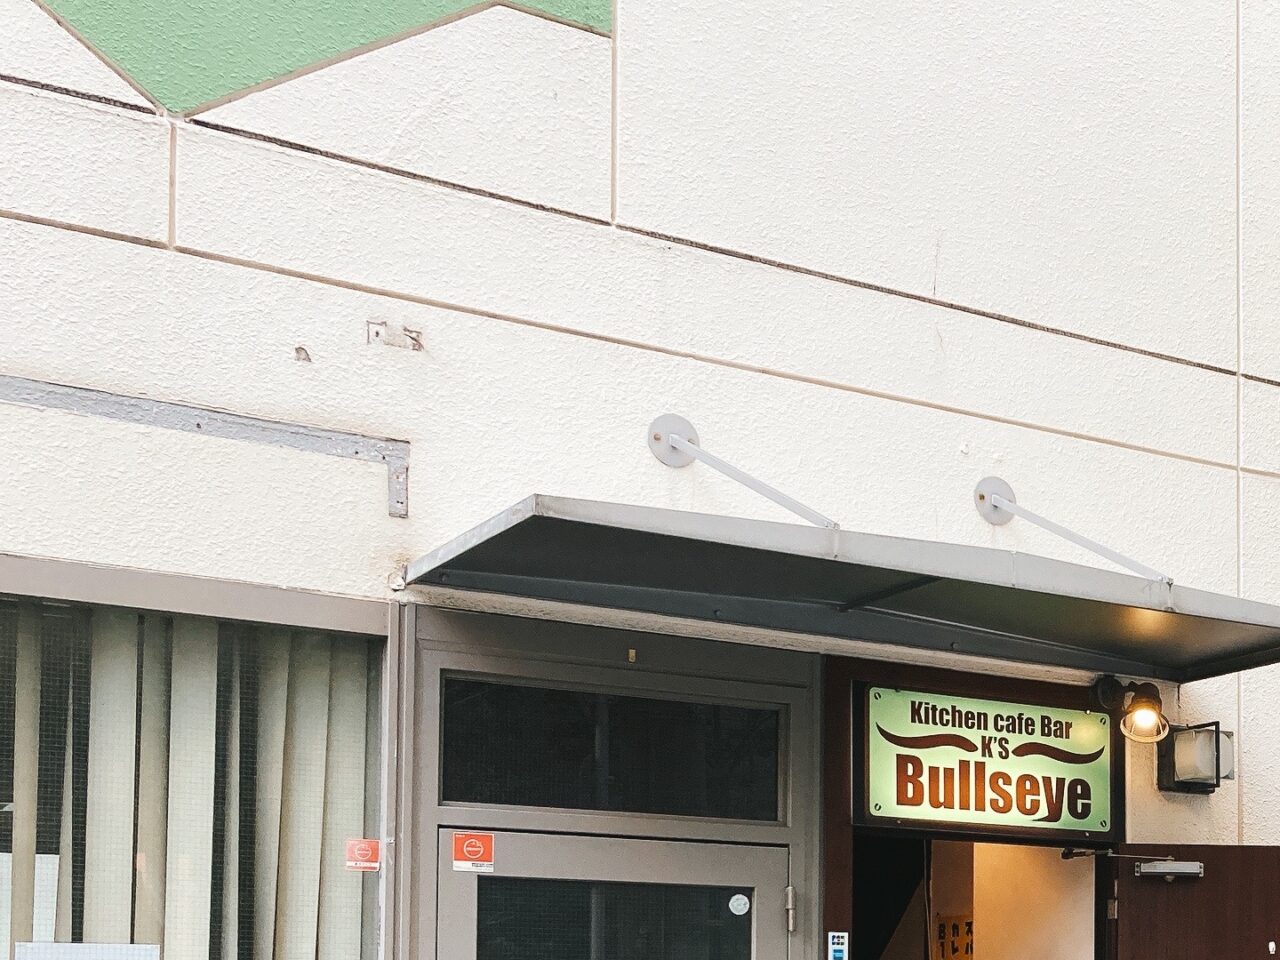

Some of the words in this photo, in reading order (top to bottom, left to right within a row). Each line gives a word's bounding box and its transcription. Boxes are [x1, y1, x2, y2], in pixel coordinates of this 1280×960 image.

[910, 700, 988, 731] Kitchen
[993, 712, 1036, 736] cafe
[1040, 715, 1073, 740] Bar
[896, 753, 1092, 822] Bullseye
